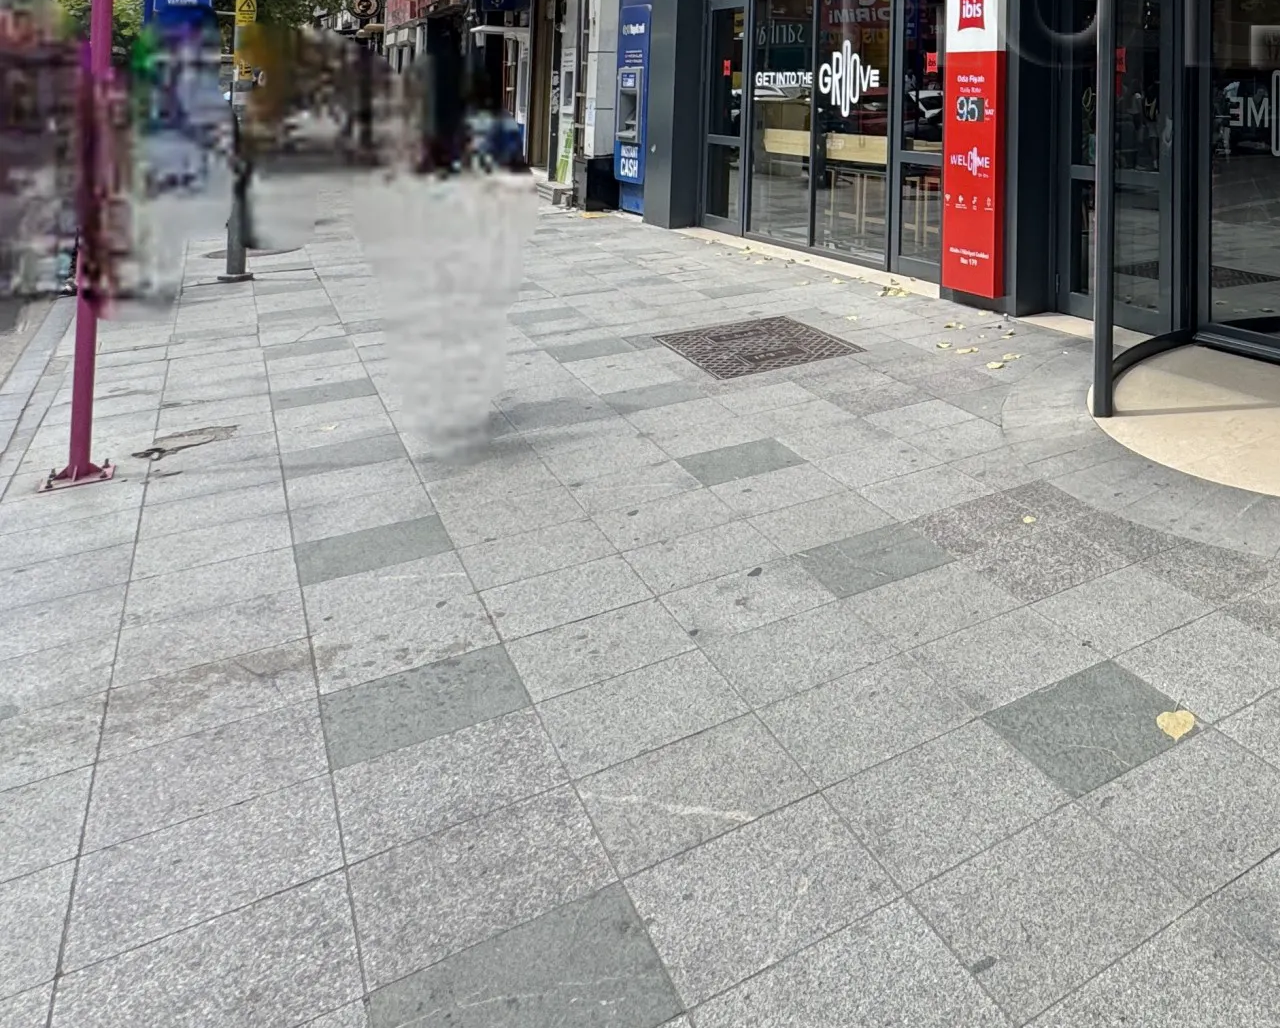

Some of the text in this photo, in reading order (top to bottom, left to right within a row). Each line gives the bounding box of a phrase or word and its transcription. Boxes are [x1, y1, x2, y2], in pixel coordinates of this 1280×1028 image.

[755, 71, 813, 86] GET INTO THE
[818, 39, 880, 118] GROOVE
[956, 96, 978, 122] 95
[620, 158, 639, 178] CASH
[950, 146, 990, 176] WELCOME
